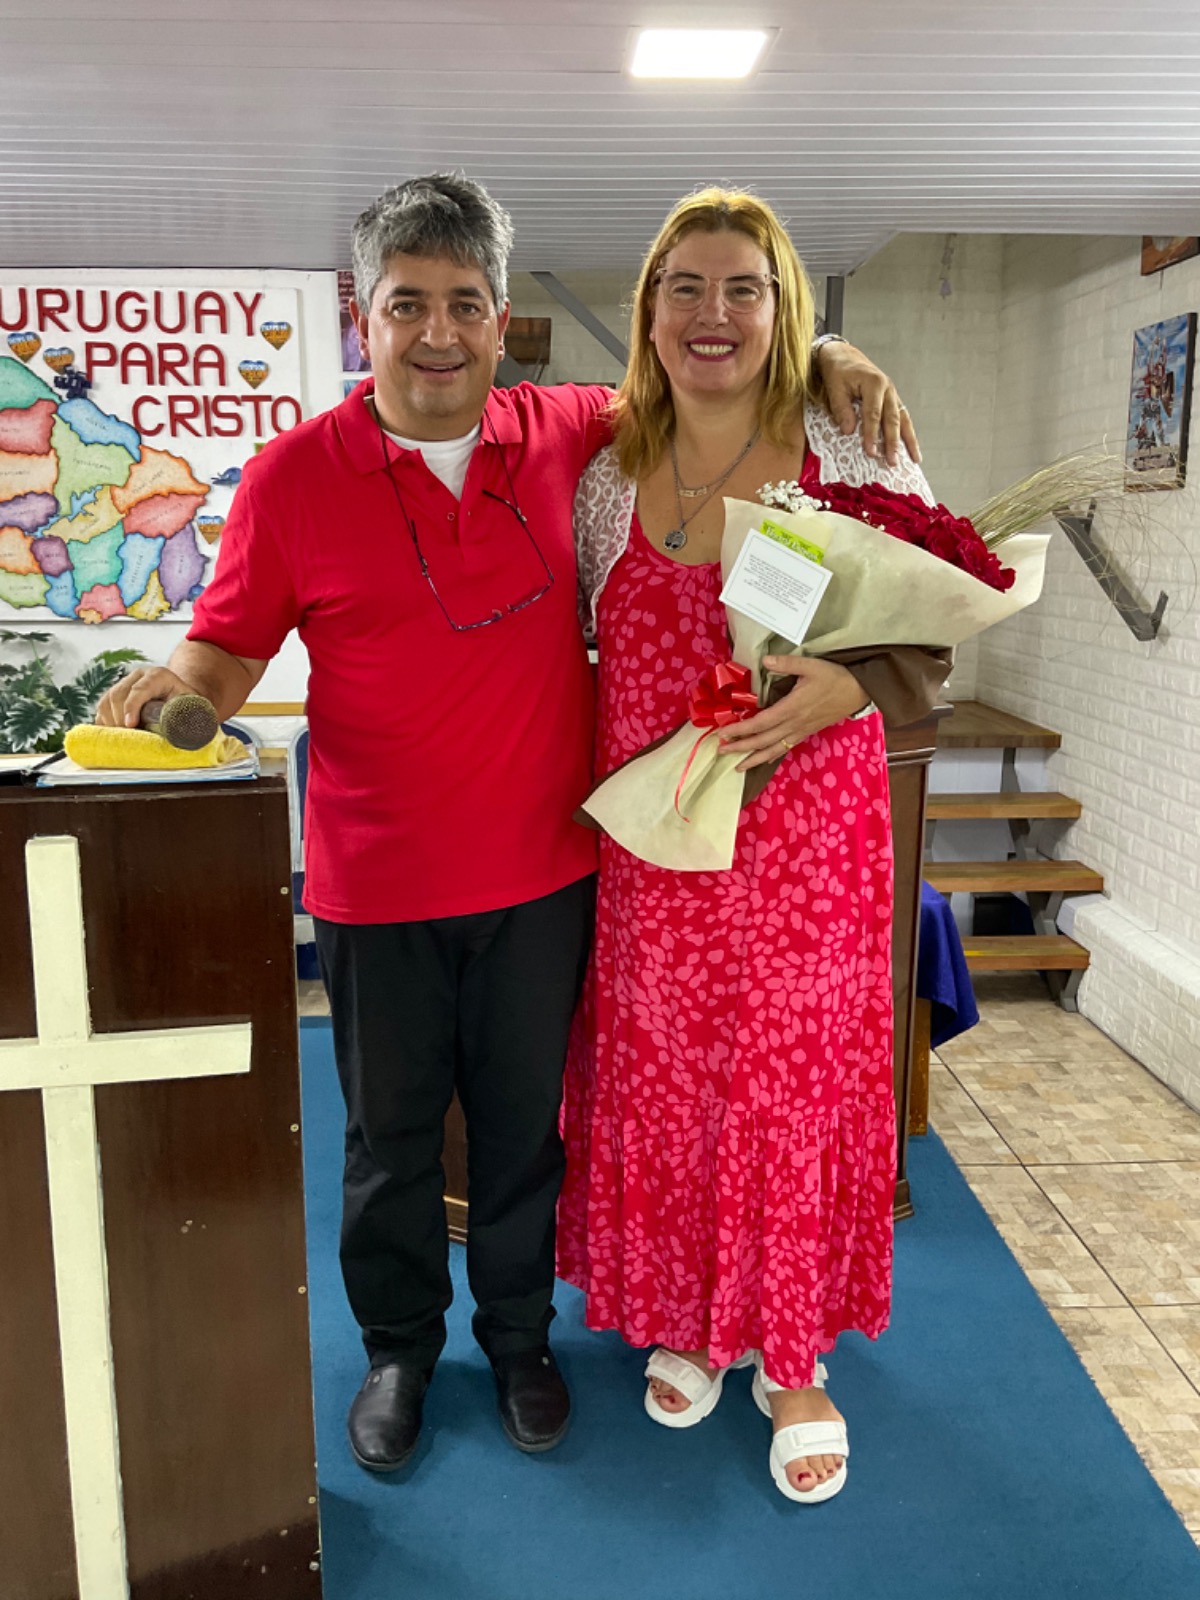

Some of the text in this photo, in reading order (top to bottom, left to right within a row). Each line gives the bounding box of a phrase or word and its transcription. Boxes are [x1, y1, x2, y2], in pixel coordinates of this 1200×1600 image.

[0, 288, 262, 337] URUGUAY
[85, 342, 227, 387] PARA
[132, 395, 302, 437] CRISTO
